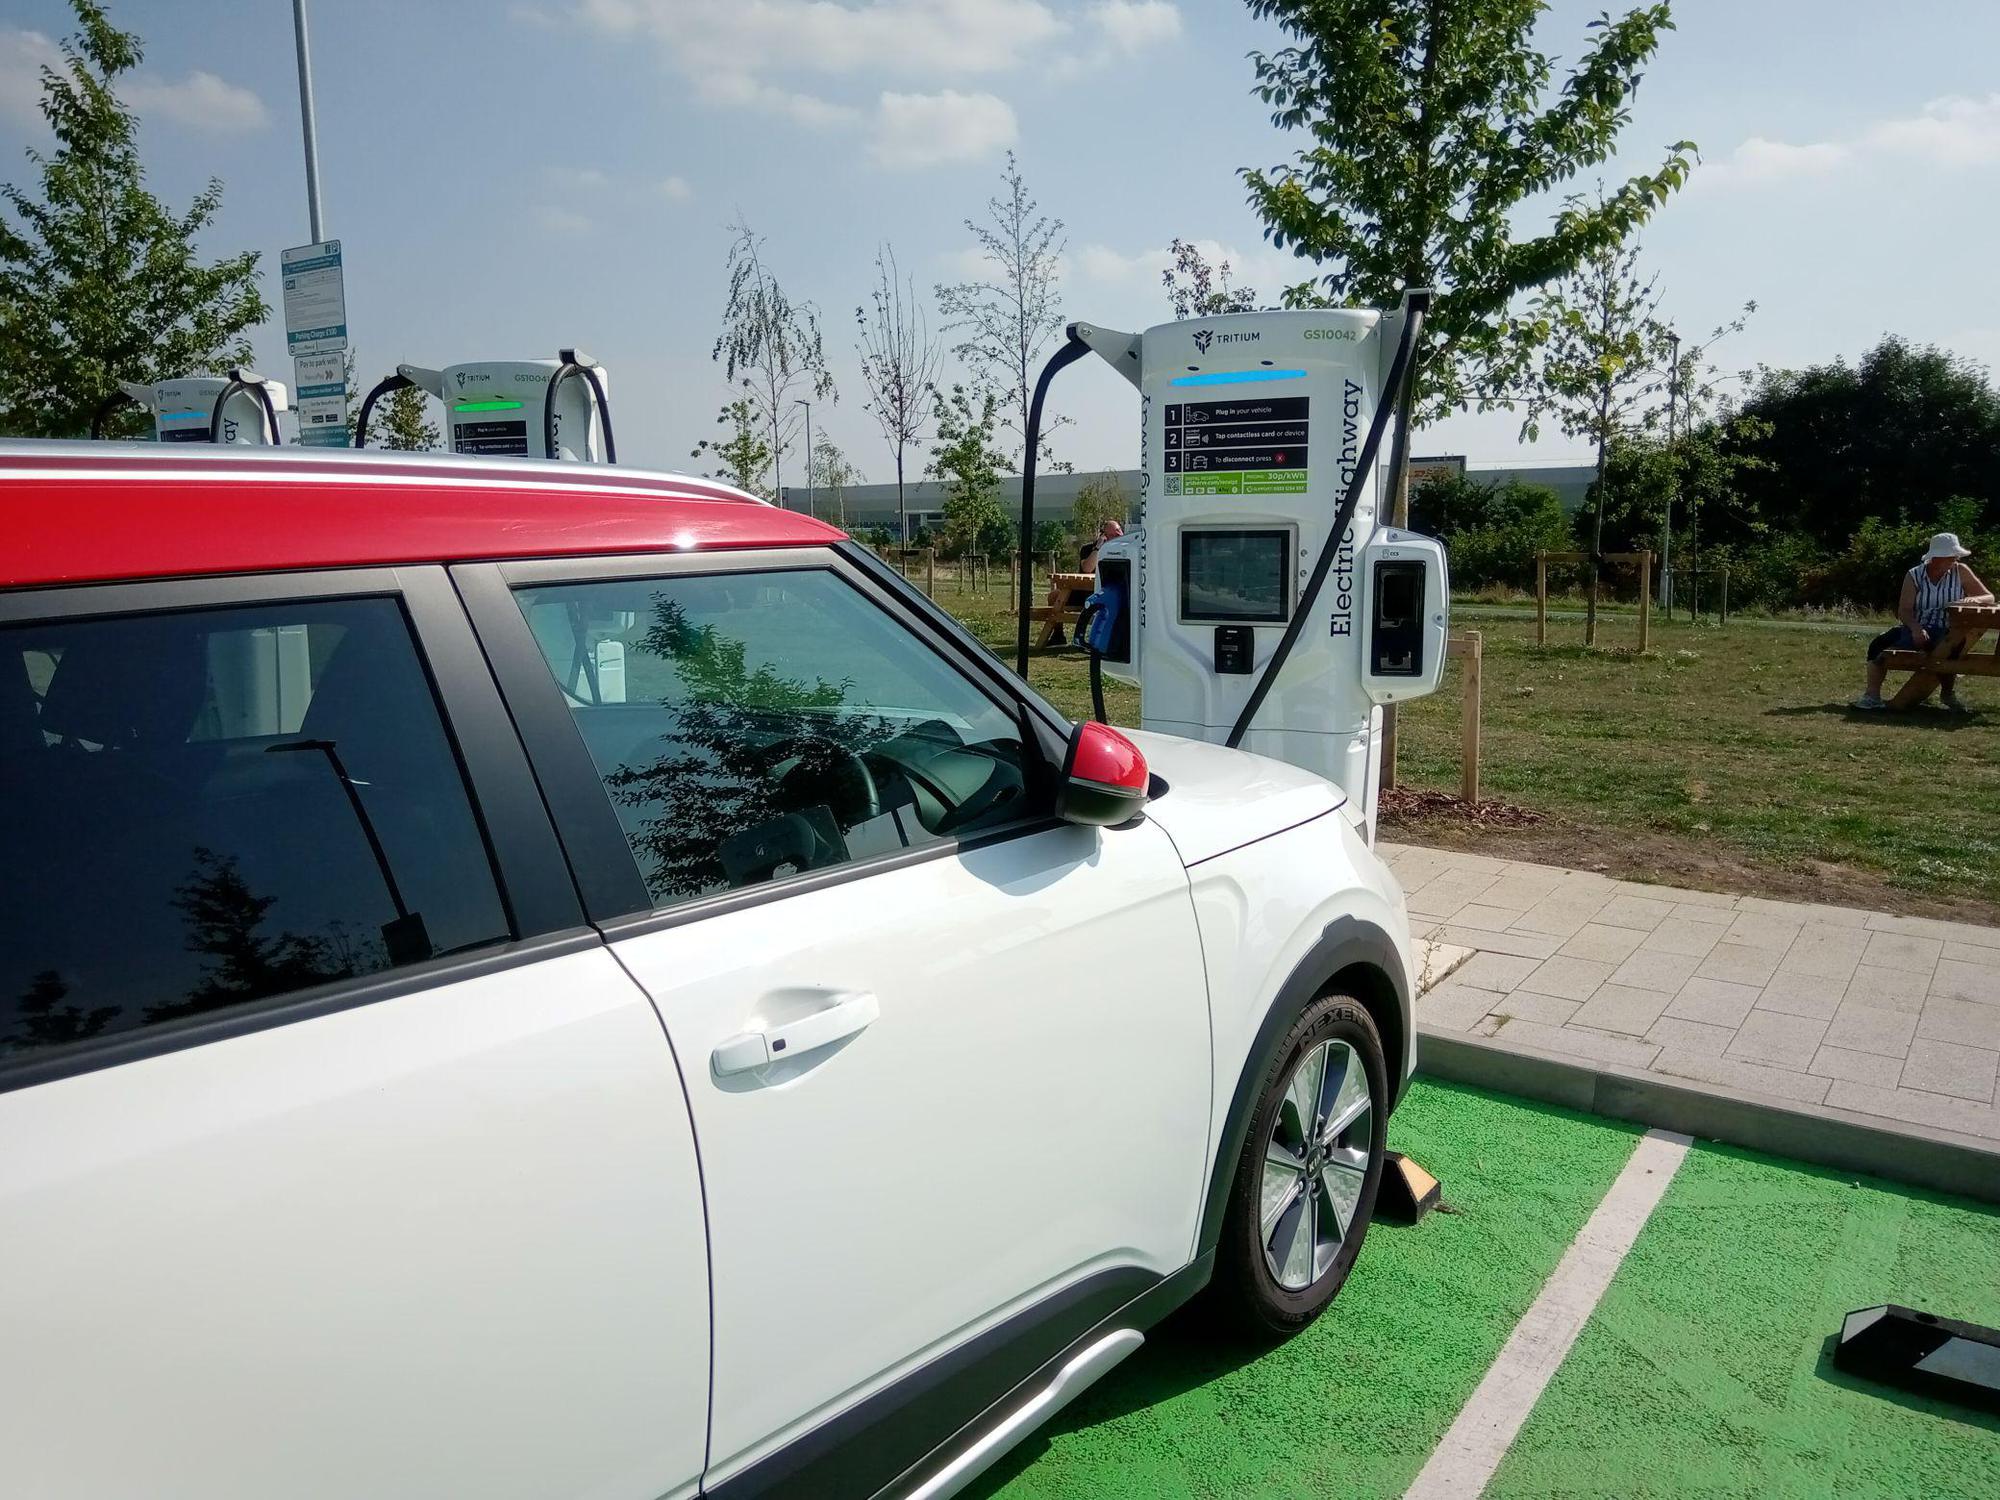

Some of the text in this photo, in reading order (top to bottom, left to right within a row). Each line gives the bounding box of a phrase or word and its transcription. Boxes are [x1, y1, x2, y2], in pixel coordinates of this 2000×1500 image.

[1217, 332, 1260, 344] TRITIUM
[1304, 330, 1356, 341] GS10042
[1170, 410, 1176, 420] 1
[1216, 408, 1228, 416] Plug
[224, 418, 239, 444] ay
[1170, 434, 1177, 444] 2
[1170, 456, 1176, 467] 3
[1268, 472, 1305, 480] 30p/kWh
[1330, 528, 1353, 638] Electric
[1301, 1008, 1364, 1047] NEXEN
